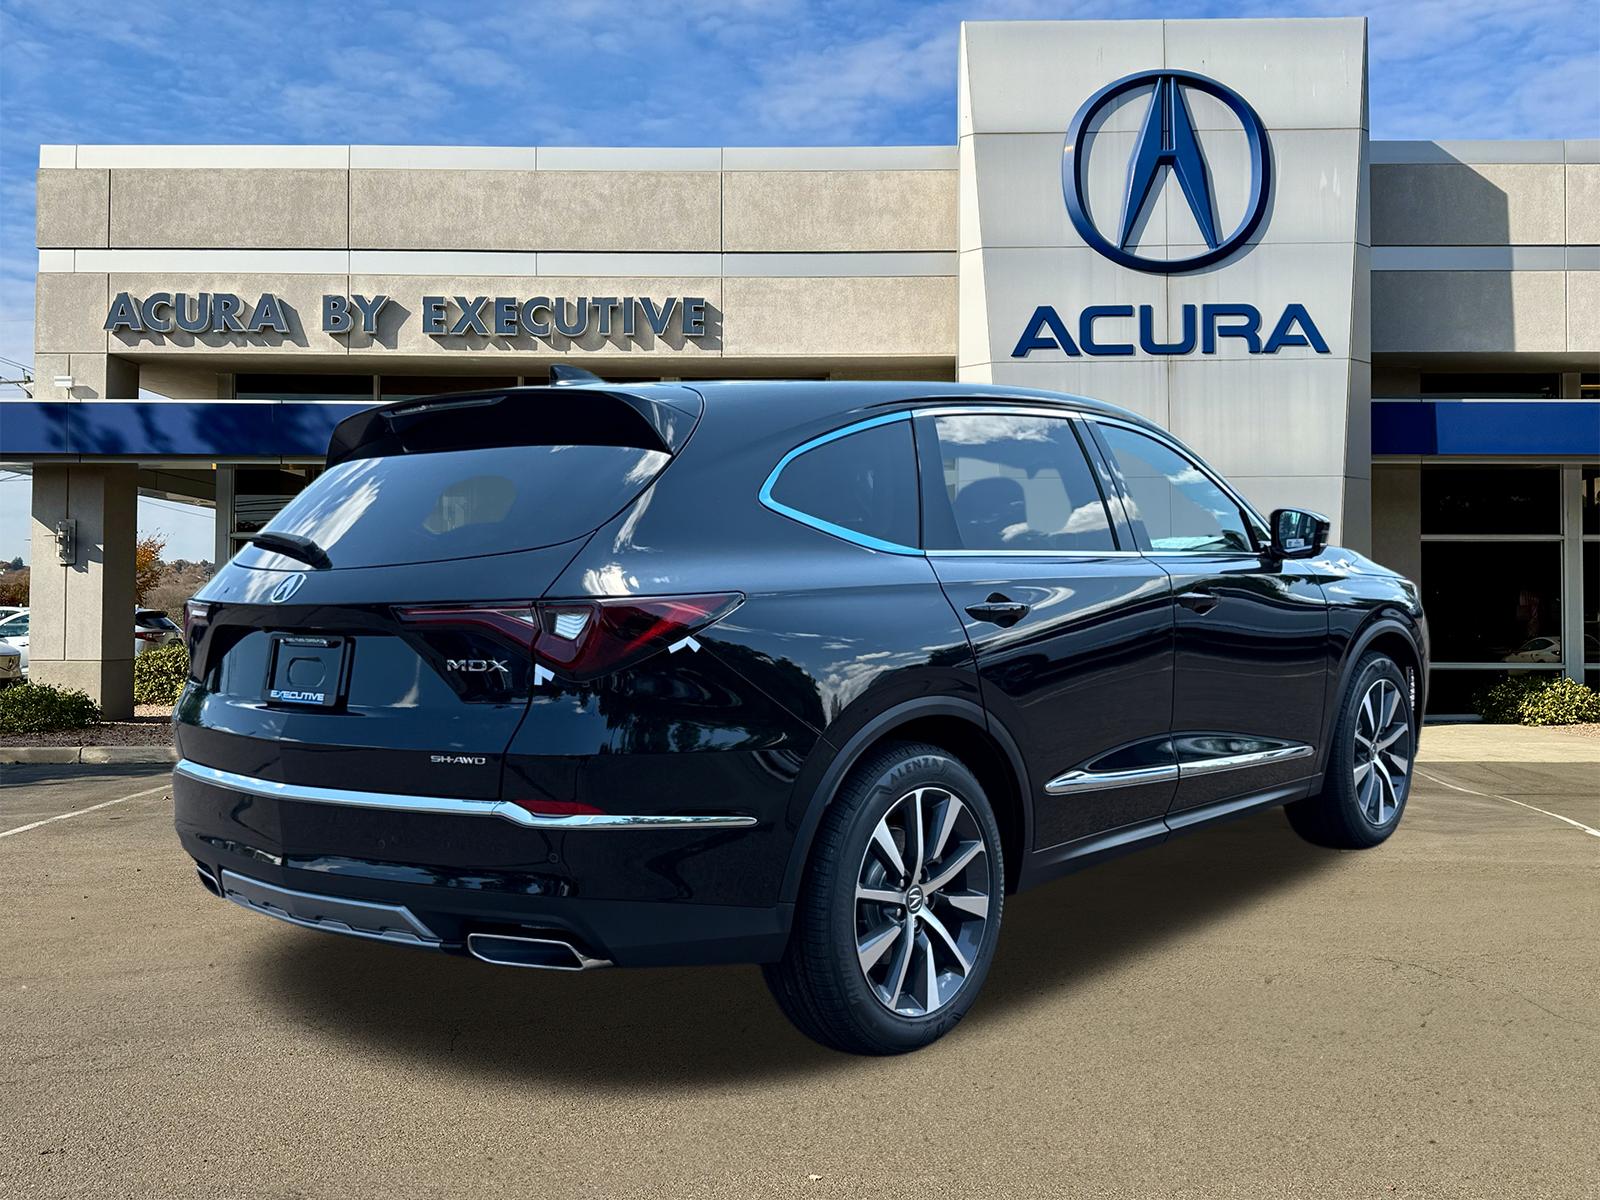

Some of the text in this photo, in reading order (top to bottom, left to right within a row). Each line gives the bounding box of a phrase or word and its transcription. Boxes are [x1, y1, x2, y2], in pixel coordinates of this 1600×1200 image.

[103, 292, 705, 336] ACURA BY EXECUTIVE
[1011, 303, 1332, 357] ACURA
[446, 659, 509, 672] MDX
[270, 690, 324, 701] EXECUTIVE
[430, 755, 486, 765] SH-AWD
